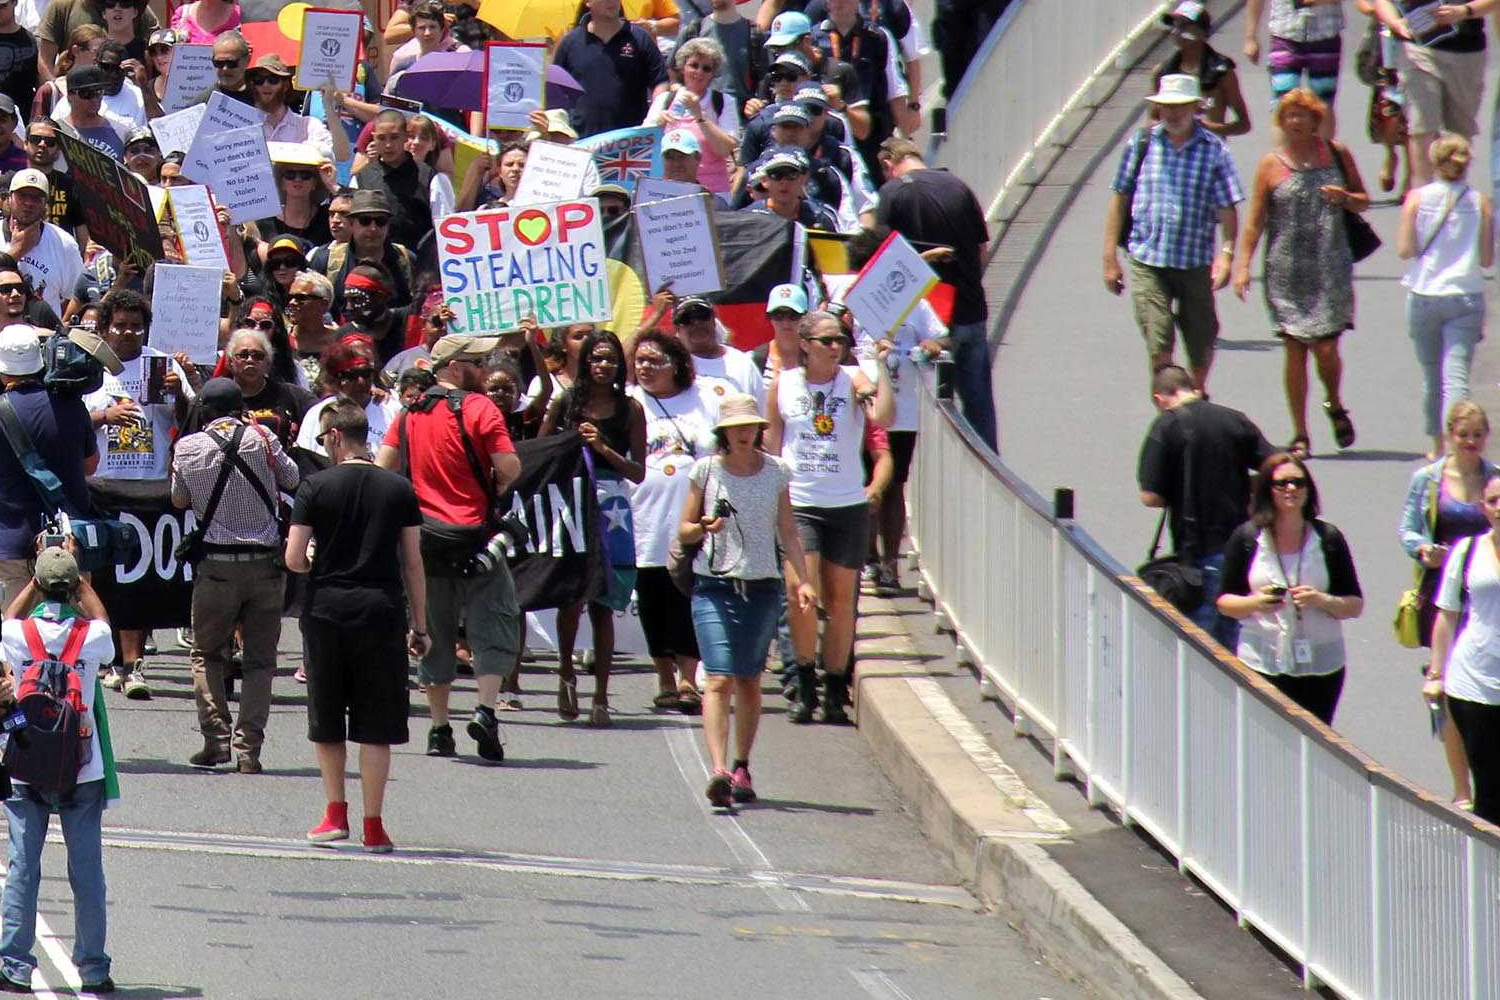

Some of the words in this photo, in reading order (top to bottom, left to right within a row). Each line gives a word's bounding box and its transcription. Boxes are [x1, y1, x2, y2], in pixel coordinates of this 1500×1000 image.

[214, 143, 233, 153] Sorry
[233, 139, 256, 149] means
[213, 156, 226, 166] you
[227, 152, 245, 162] don't
[247, 151, 255, 159] do
[245, 174, 259, 183] 2nd
[234, 188, 256, 197] Stolen
[439, 202, 595, 256] STOP
[441, 242, 599, 294] STEALING
[446, 279, 607, 334] CHILDREN!
